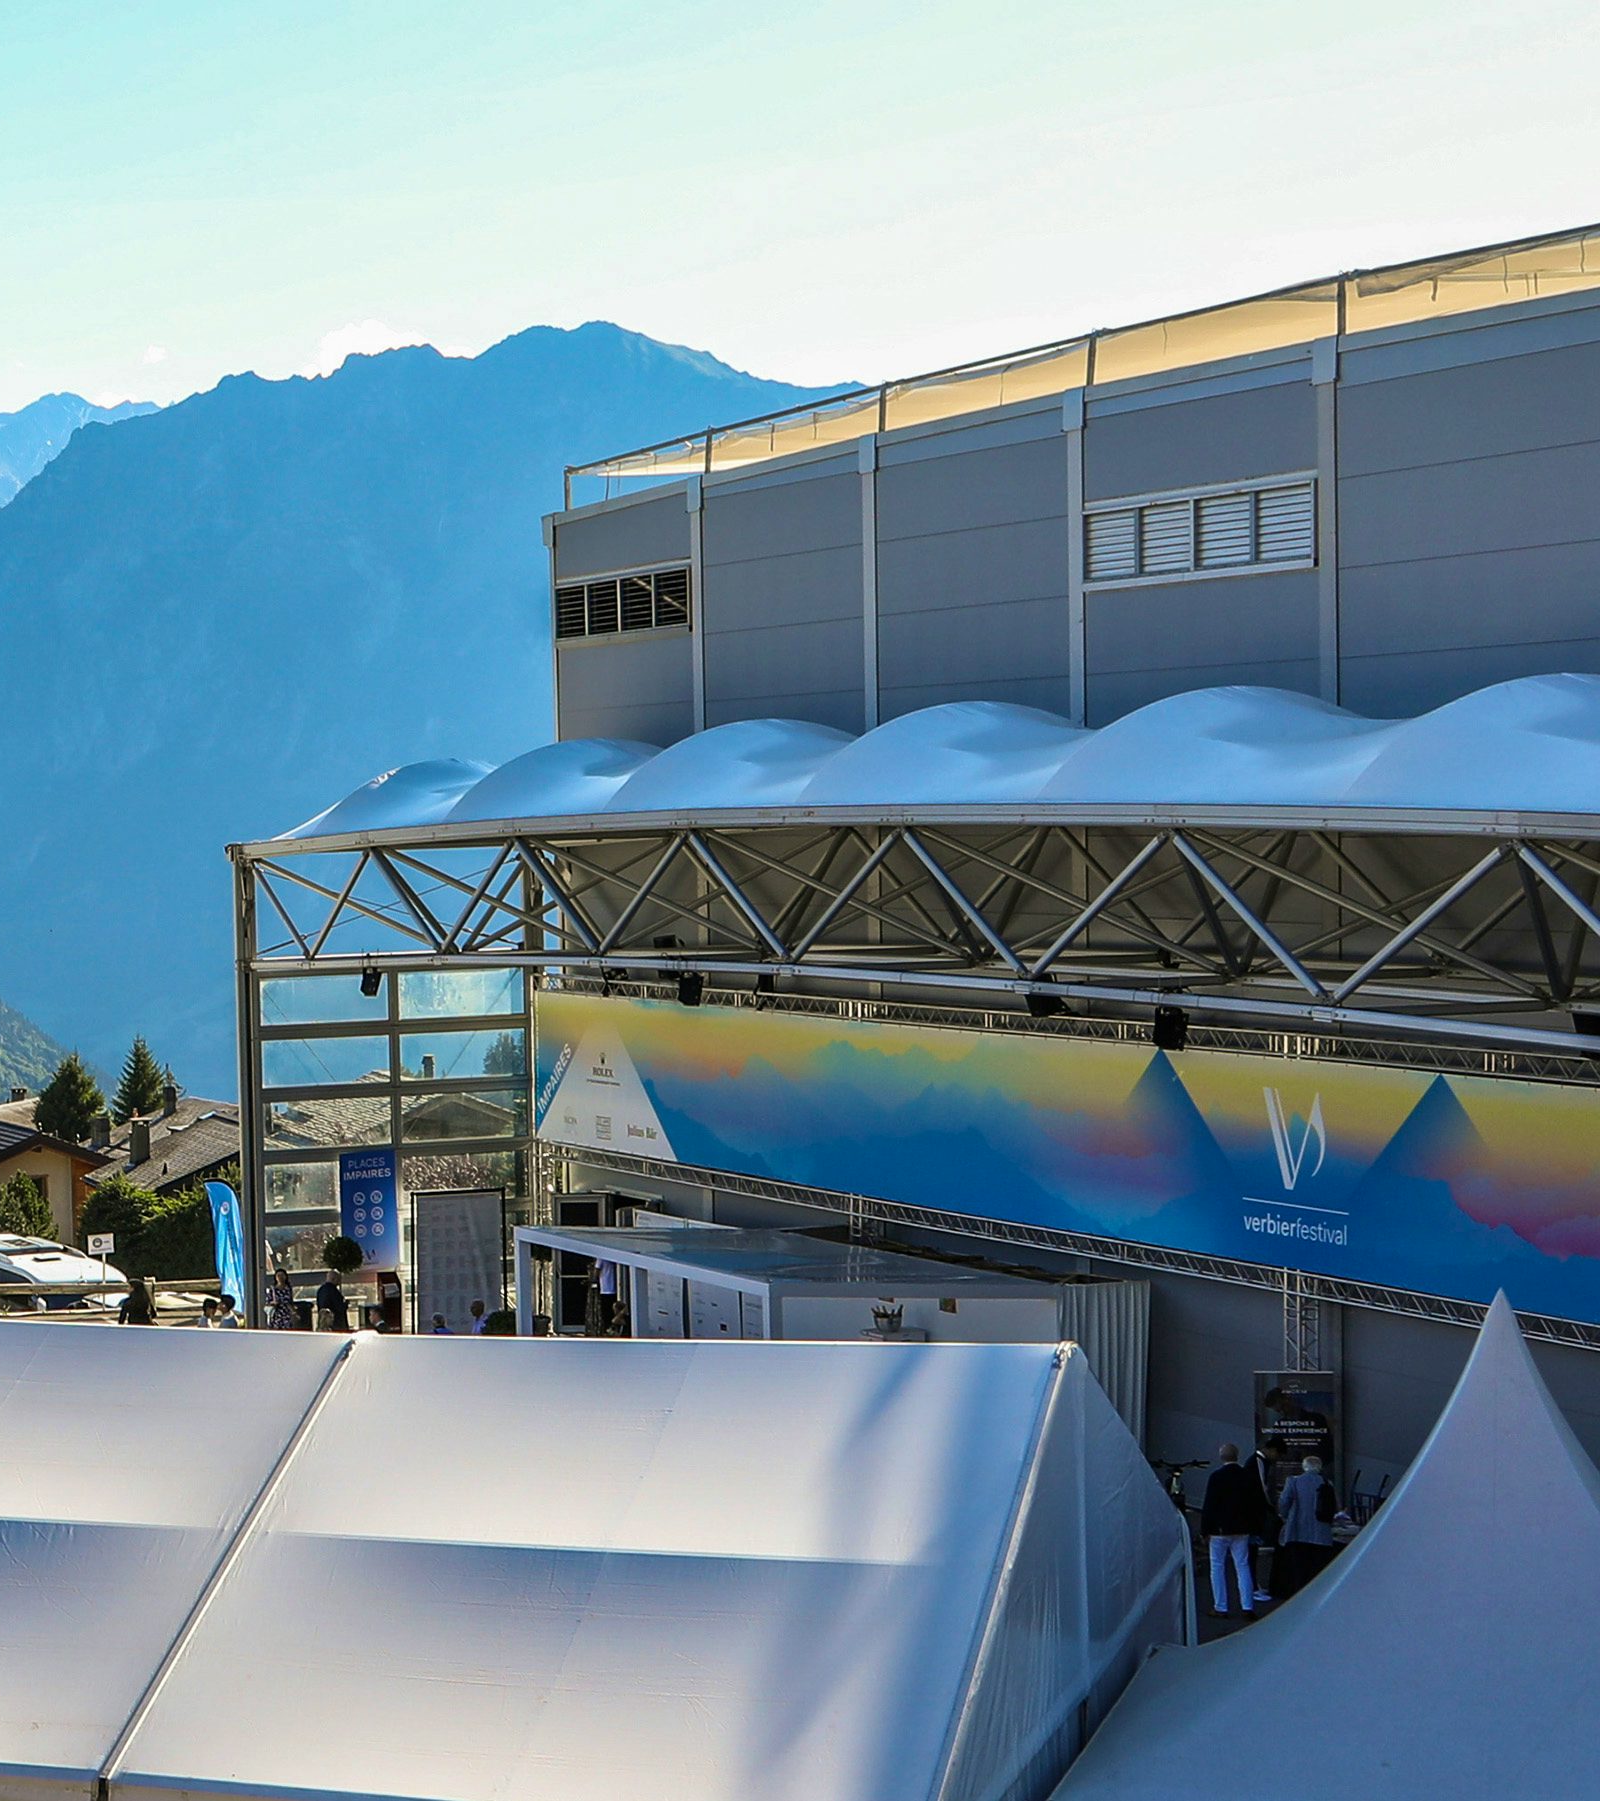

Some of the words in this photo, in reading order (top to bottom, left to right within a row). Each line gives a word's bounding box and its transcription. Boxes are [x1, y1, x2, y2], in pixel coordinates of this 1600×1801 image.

[537, 1043, 571, 1114] IMPAIRES
[592, 1066, 614, 1078] ROLEX
[627, 1123, 645, 1138] Julius
[348, 1157, 385, 1169] PLACES
[343, 1168, 391, 1180] IMPAIRES
[1243, 1213, 1348, 1246] verbierfestival
